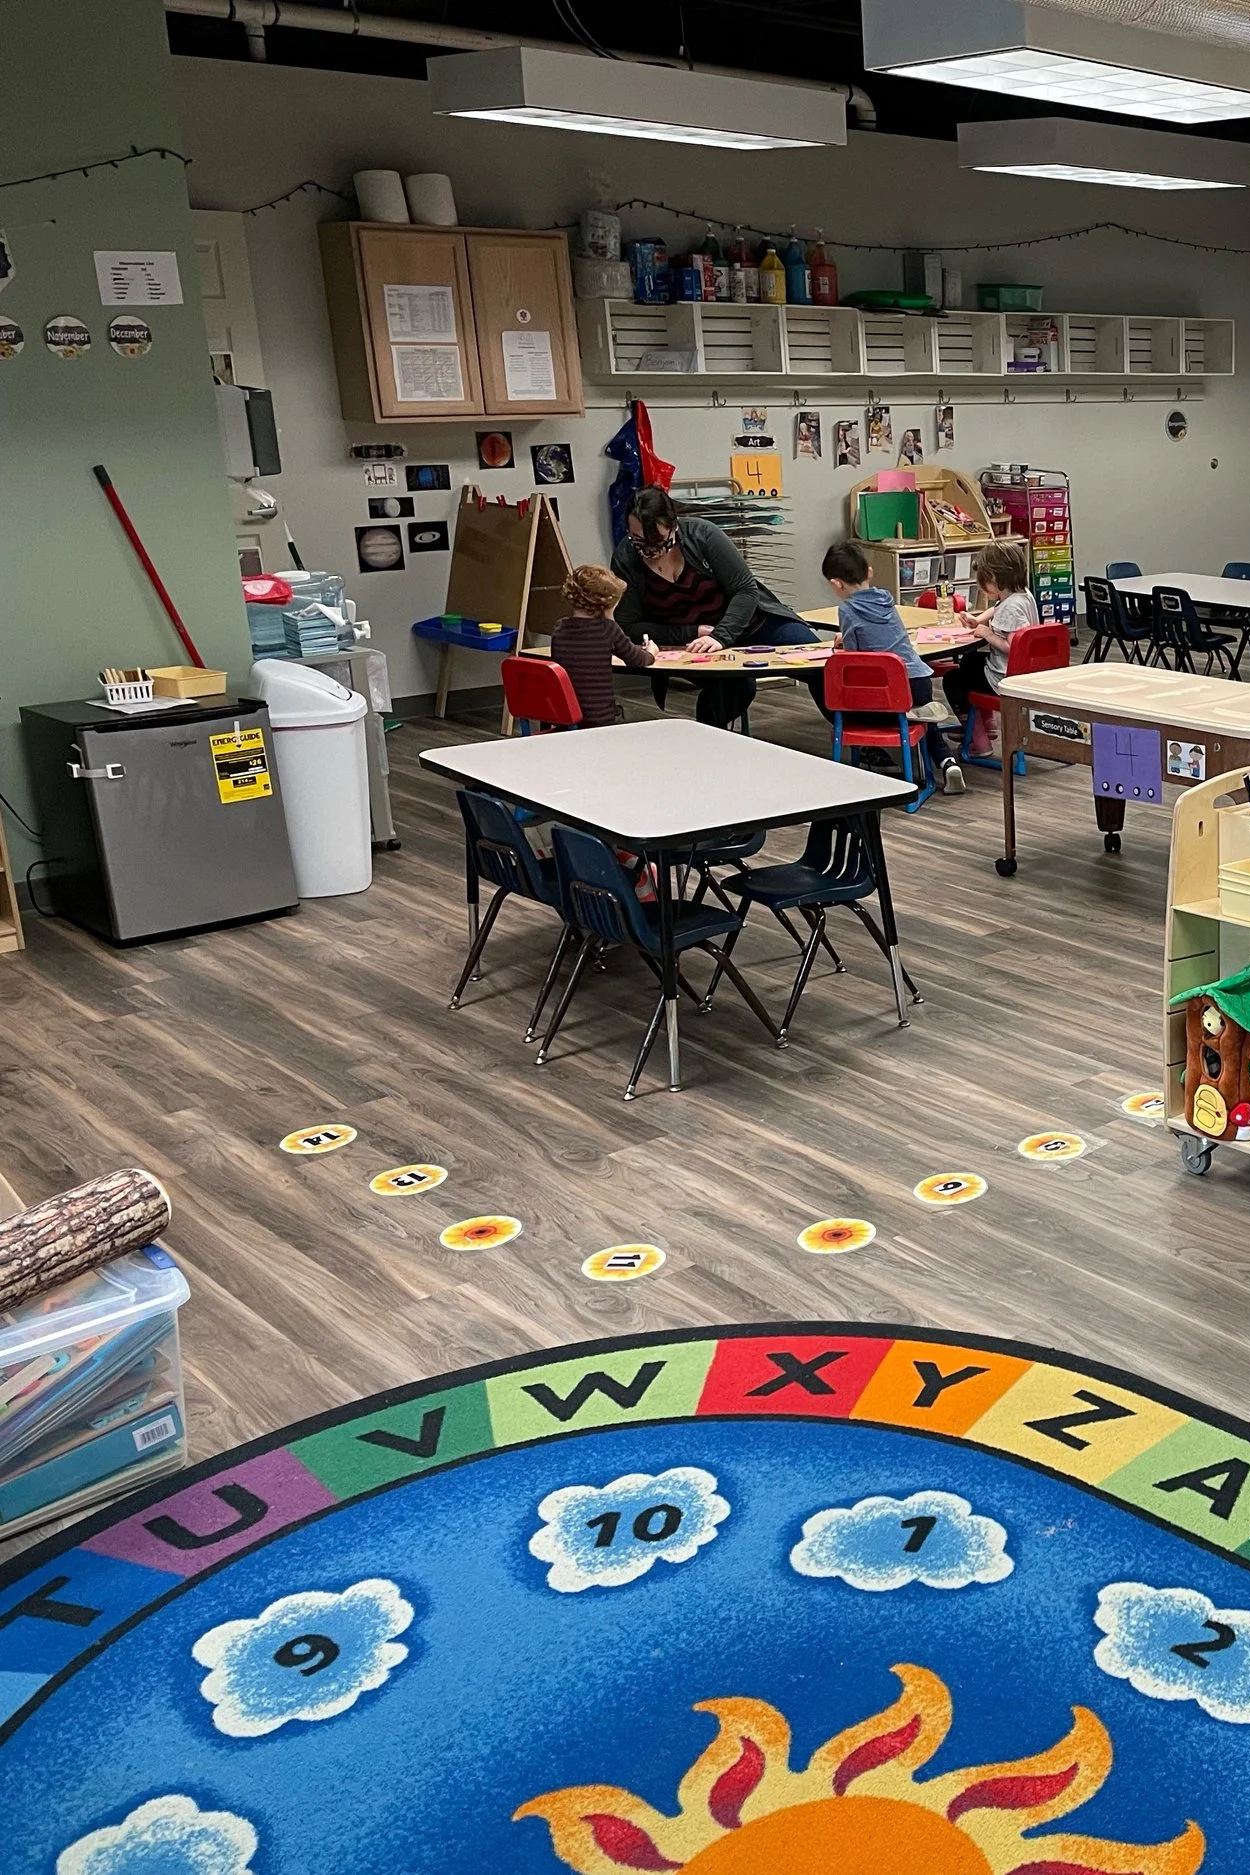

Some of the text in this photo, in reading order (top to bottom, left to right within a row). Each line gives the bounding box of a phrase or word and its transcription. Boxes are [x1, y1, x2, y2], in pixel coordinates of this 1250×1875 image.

[47, 331, 89, 342] November
[110, 328, 149, 339] December
[748, 438, 760, 446] Art
[746, 461, 763, 485] 4
[1041, 720, 1078, 736] Sensory Table
[1114, 732, 1139, 777] 4
[302, 1132, 341, 1146] 14
[391, 1172, 428, 1187] 13
[520, 1360, 668, 1422] W
[744, 1351, 850, 1398] X
[911, 1361, 989, 1408] Y
[358, 1407, 447, 1459] V
[1023, 1389, 1139, 1451] Z
[142, 1483, 268, 1551] U
[586, 1503, 682, 1549] 10
[900, 1516, 938, 1553] 1
[0, 1576, 103, 1629] T
[273, 1634, 341, 1678] 9
[1171, 1620, 1236, 1669] 2
